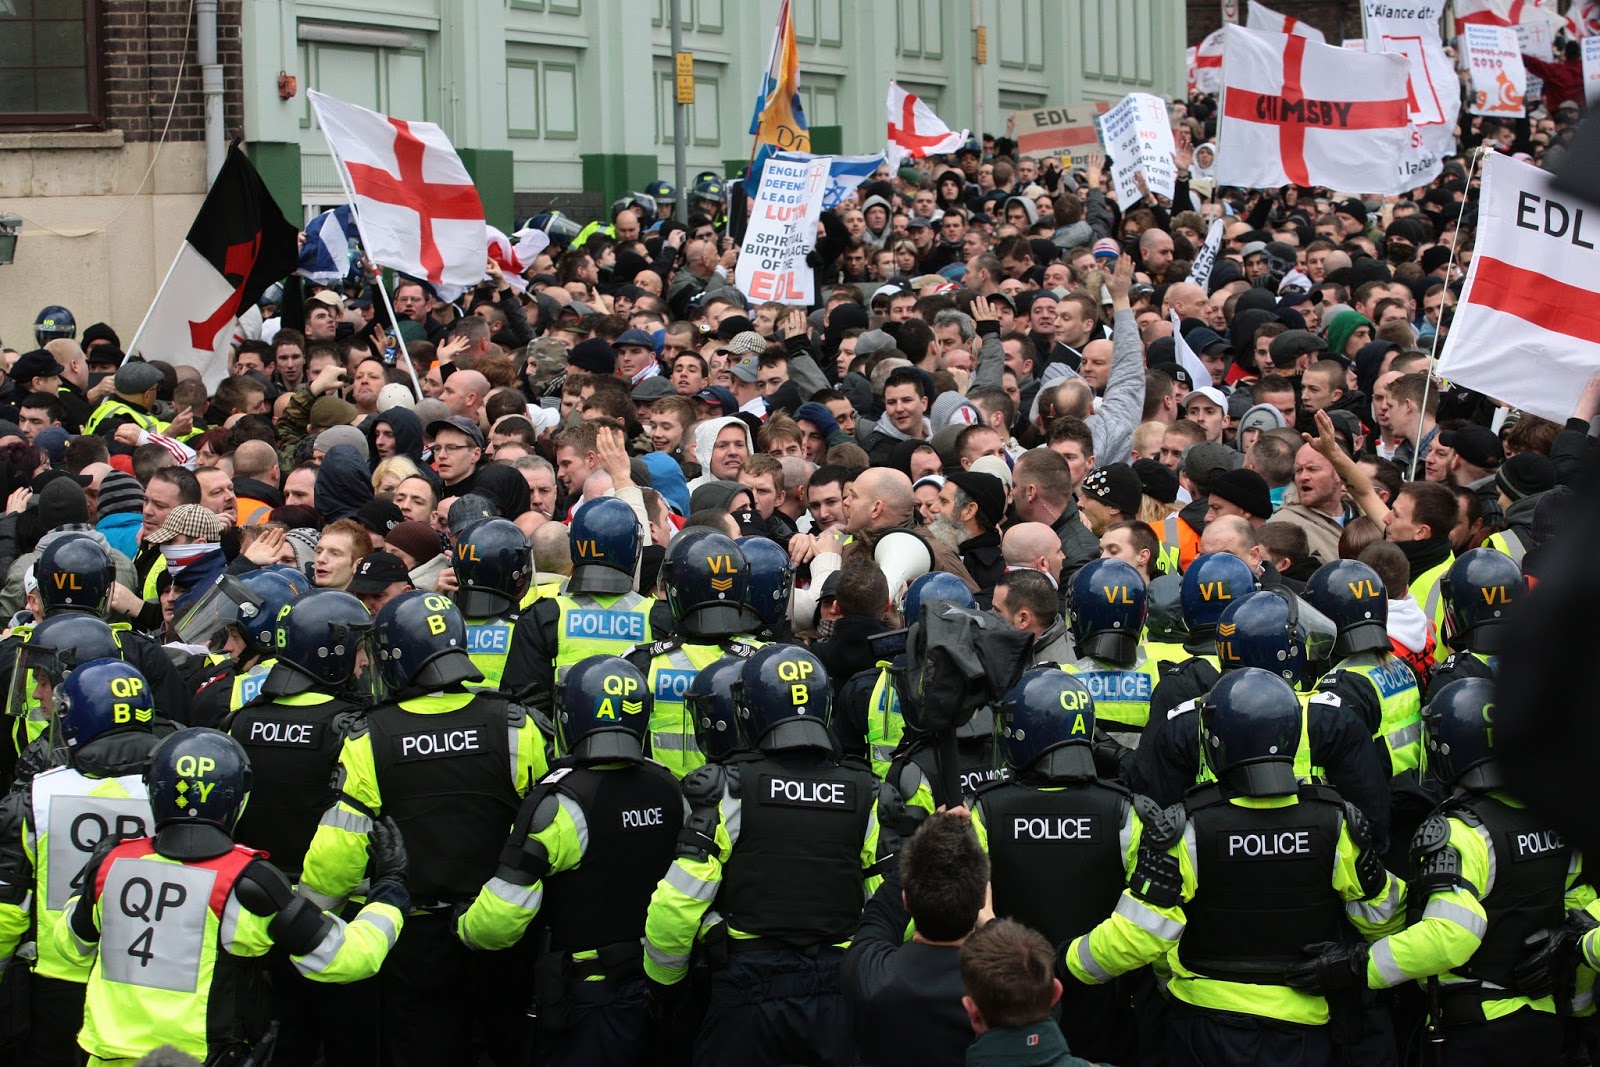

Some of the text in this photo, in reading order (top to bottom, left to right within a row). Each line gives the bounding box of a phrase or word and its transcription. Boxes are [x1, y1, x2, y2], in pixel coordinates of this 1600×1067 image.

[1034, 109, 1077, 127] EDL
[1104, 97, 1137, 124] ENGLISH
[1107, 106, 1139, 132] DEFENCE
[1109, 114, 1142, 141] LEAGUE
[1139, 130, 1157, 139] NO
[1144, 142, 1153, 150] A
[1517, 190, 1594, 250] EDL
[761, 259, 781, 271] OF
[748, 271, 804, 300] EDL
[457, 543, 481, 562] VL
[576, 540, 604, 557] VL
[706, 555, 738, 574] VL
[53, 572, 82, 590] VL
[1199, 582, 1232, 601] VL
[1348, 580, 1380, 599] VL
[424, 595, 453, 611] QP
[1103, 585, 1134, 604] VL
[1481, 585, 1513, 605] VL
[427, 614, 447, 635] B
[569, 613, 642, 637] POLICE
[277, 628, 287, 648] B
[467, 629, 506, 649] LICE
[1216, 641, 1240, 661] VL
[777, 660, 813, 682] QP
[111, 677, 143, 698] QP
[603, 674, 638, 696] QP
[791, 683, 809, 706] B
[596, 698, 616, 720] A
[1060, 690, 1089, 711] QP
[114, 703, 131, 723] B
[1070, 713, 1086, 735] A
[251, 722, 313, 744] POLICE
[402, 729, 479, 755] POLICE
[175, 755, 216, 778] QP
[197, 780, 216, 803] Y
[770, 779, 845, 804] POLICE
[621, 807, 663, 829] POLICE
[1014, 818, 1091, 839] POLICE
[70, 812, 145, 853] QP
[1517, 829, 1565, 855] POLICE
[1229, 832, 1310, 856] POLICE
[120, 876, 187, 923] QP
[127, 927, 154, 967] 4
